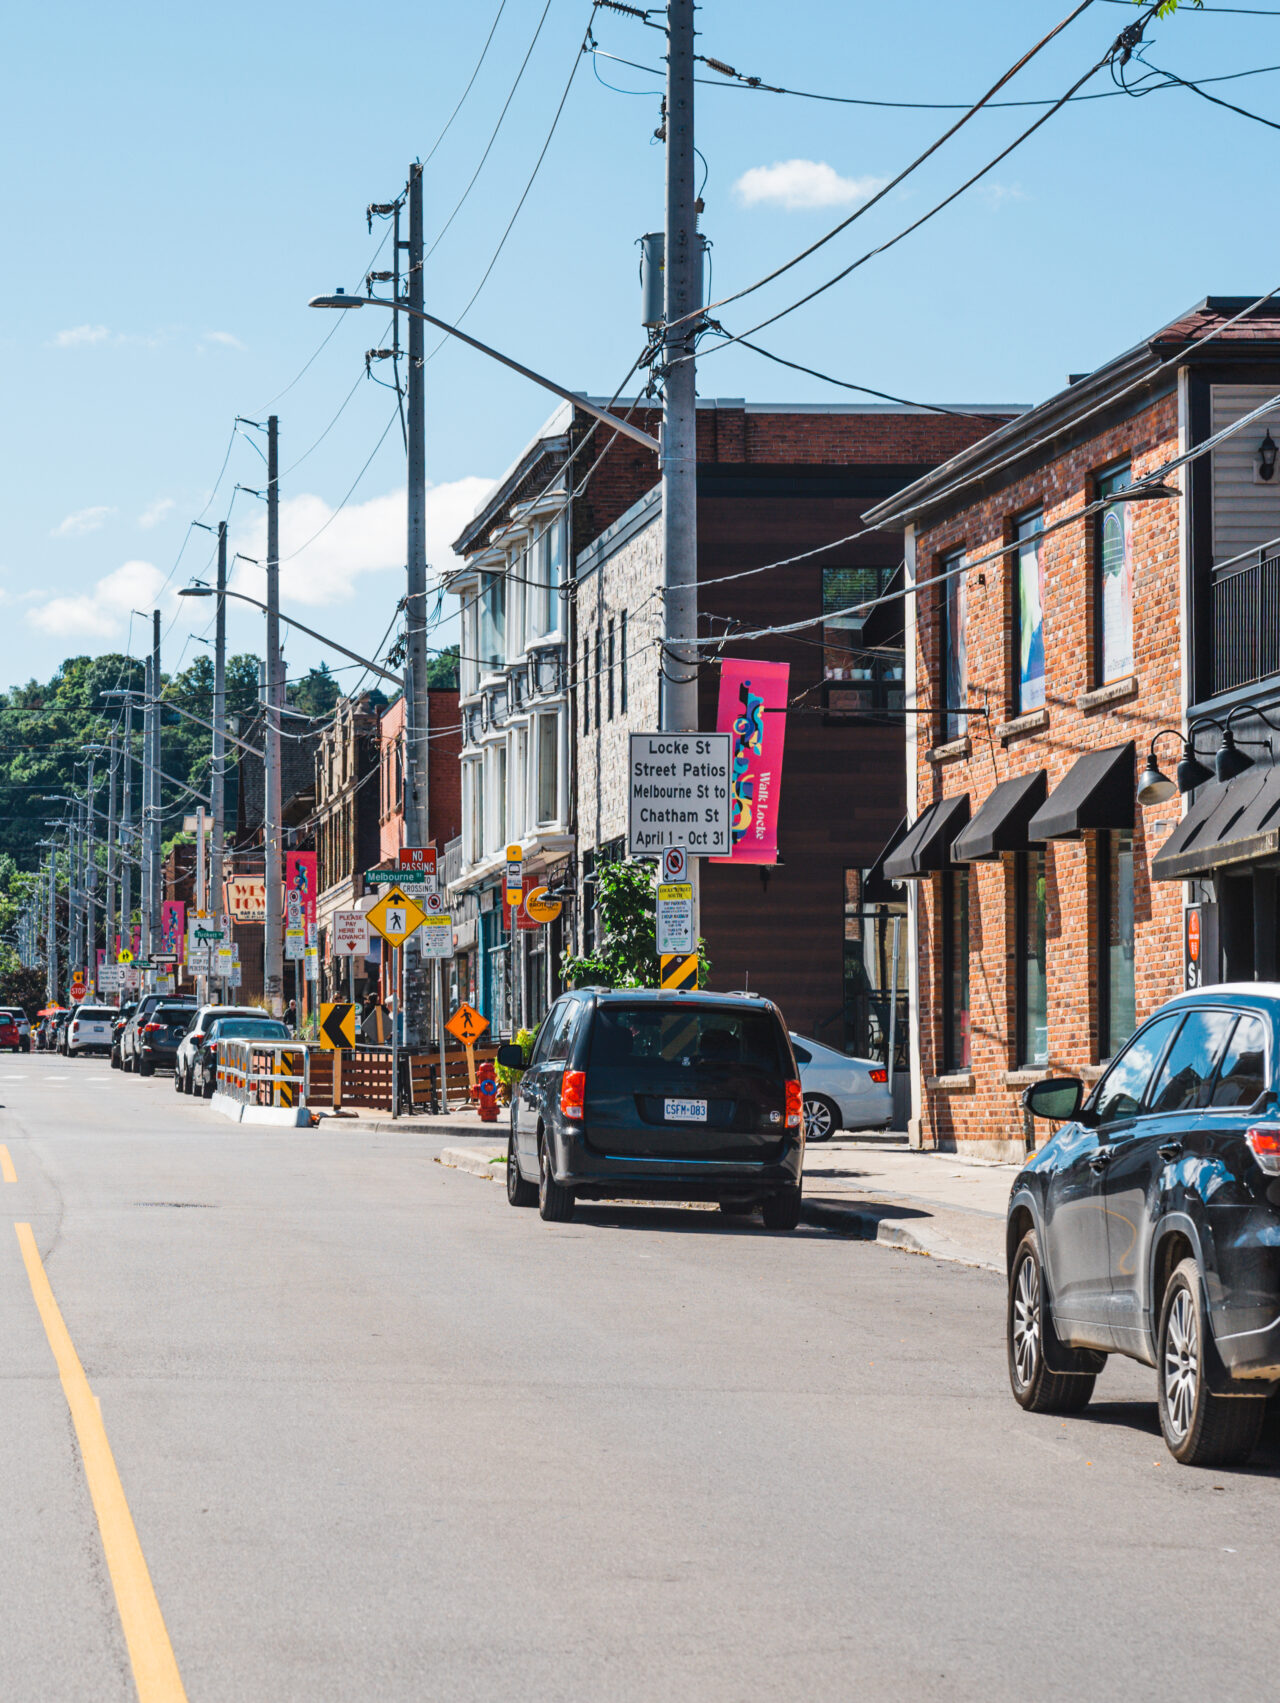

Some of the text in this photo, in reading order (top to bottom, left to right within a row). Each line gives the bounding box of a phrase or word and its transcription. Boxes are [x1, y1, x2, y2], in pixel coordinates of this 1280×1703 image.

[649, 740, 711, 755] Locke St
[634, 762, 726, 777] Street Patios
[633, 783, 726, 799] Melbourne St to
[755, 771, 771, 840] Walk Locke
[640, 808, 719, 822] Chatham St
[636, 831, 664, 848] April
[669, 831, 673, 845] 1
[688, 831, 708, 845] Oct
[713, 831, 724, 845] 31
[412, 850, 424, 861] NO
[401, 862, 435, 873] PASSING
[367, 872, 415, 881] Melbourne
[234, 885, 266, 896] WES
[402, 884, 433, 893] CROSSING
[233, 898, 266, 909] TOW
[71, 987, 86, 995] STOP
